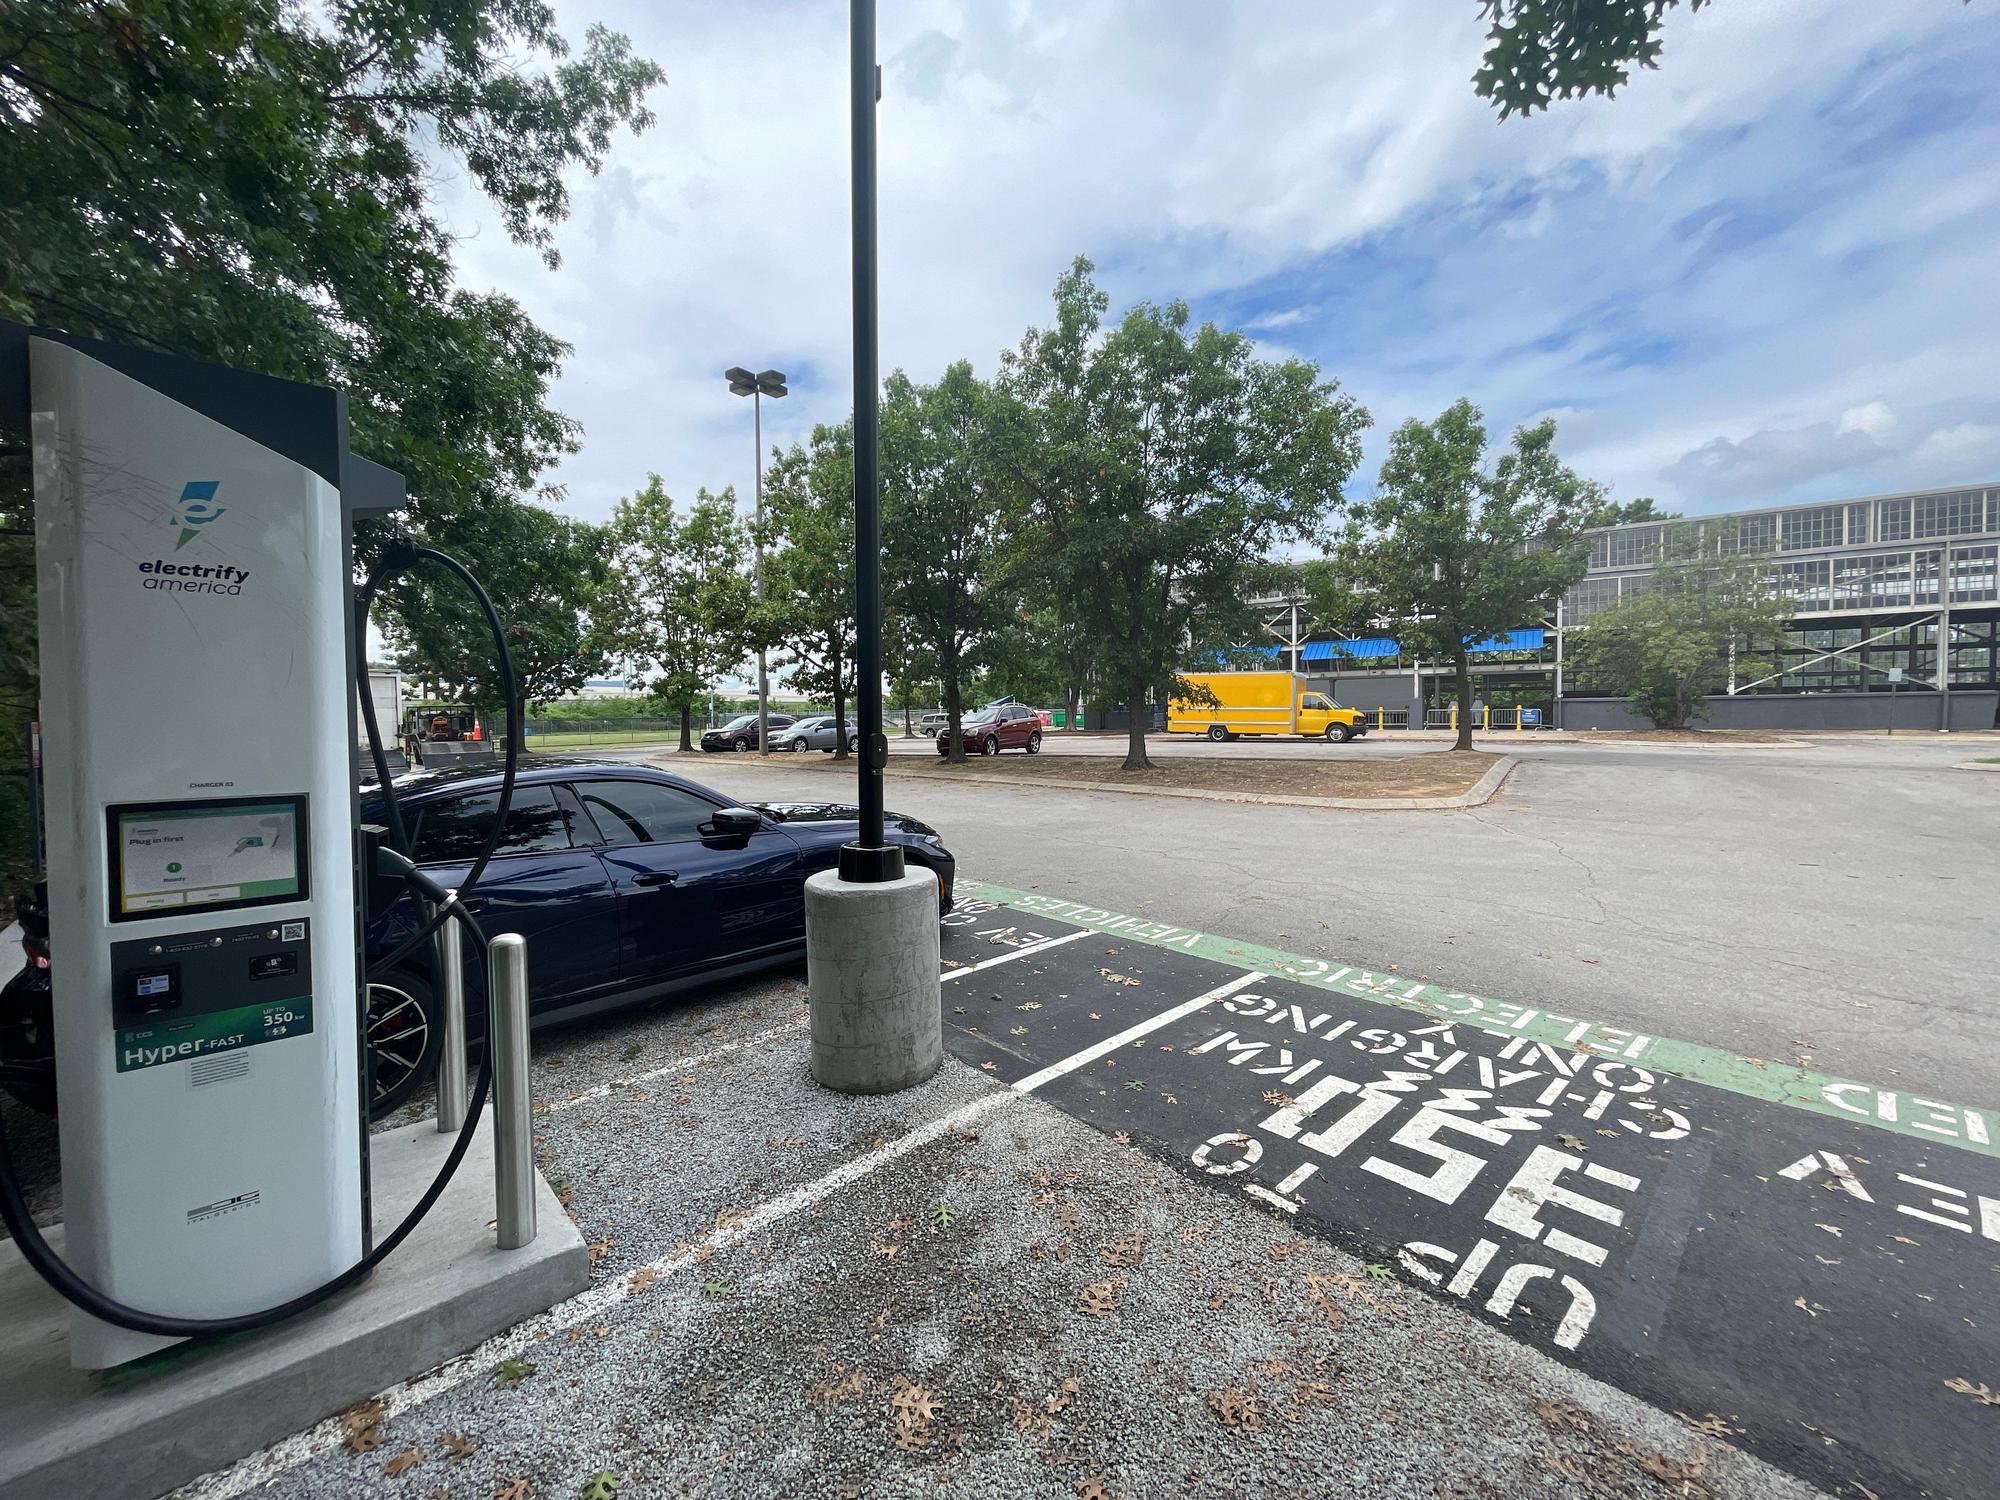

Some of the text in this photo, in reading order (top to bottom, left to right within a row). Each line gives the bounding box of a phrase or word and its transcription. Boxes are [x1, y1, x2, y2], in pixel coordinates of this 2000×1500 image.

[139, 560, 250, 584] electrify
[143, 578, 242, 595] america
[1014, 895, 1204, 948] VEHICLES
[136, 1030, 153, 1039] CCS
[263, 1011, 293, 1026] 350
[1284, 959, 1652, 1060] ELECTRIC
[1410, 1023, 1656, 1094] ONLY
[1199, 1031, 1642, 1268] 350 KW
[1222, 994, 2000, 1243] EV CHARGING
[1192, 1132, 1598, 1351] UP TO
